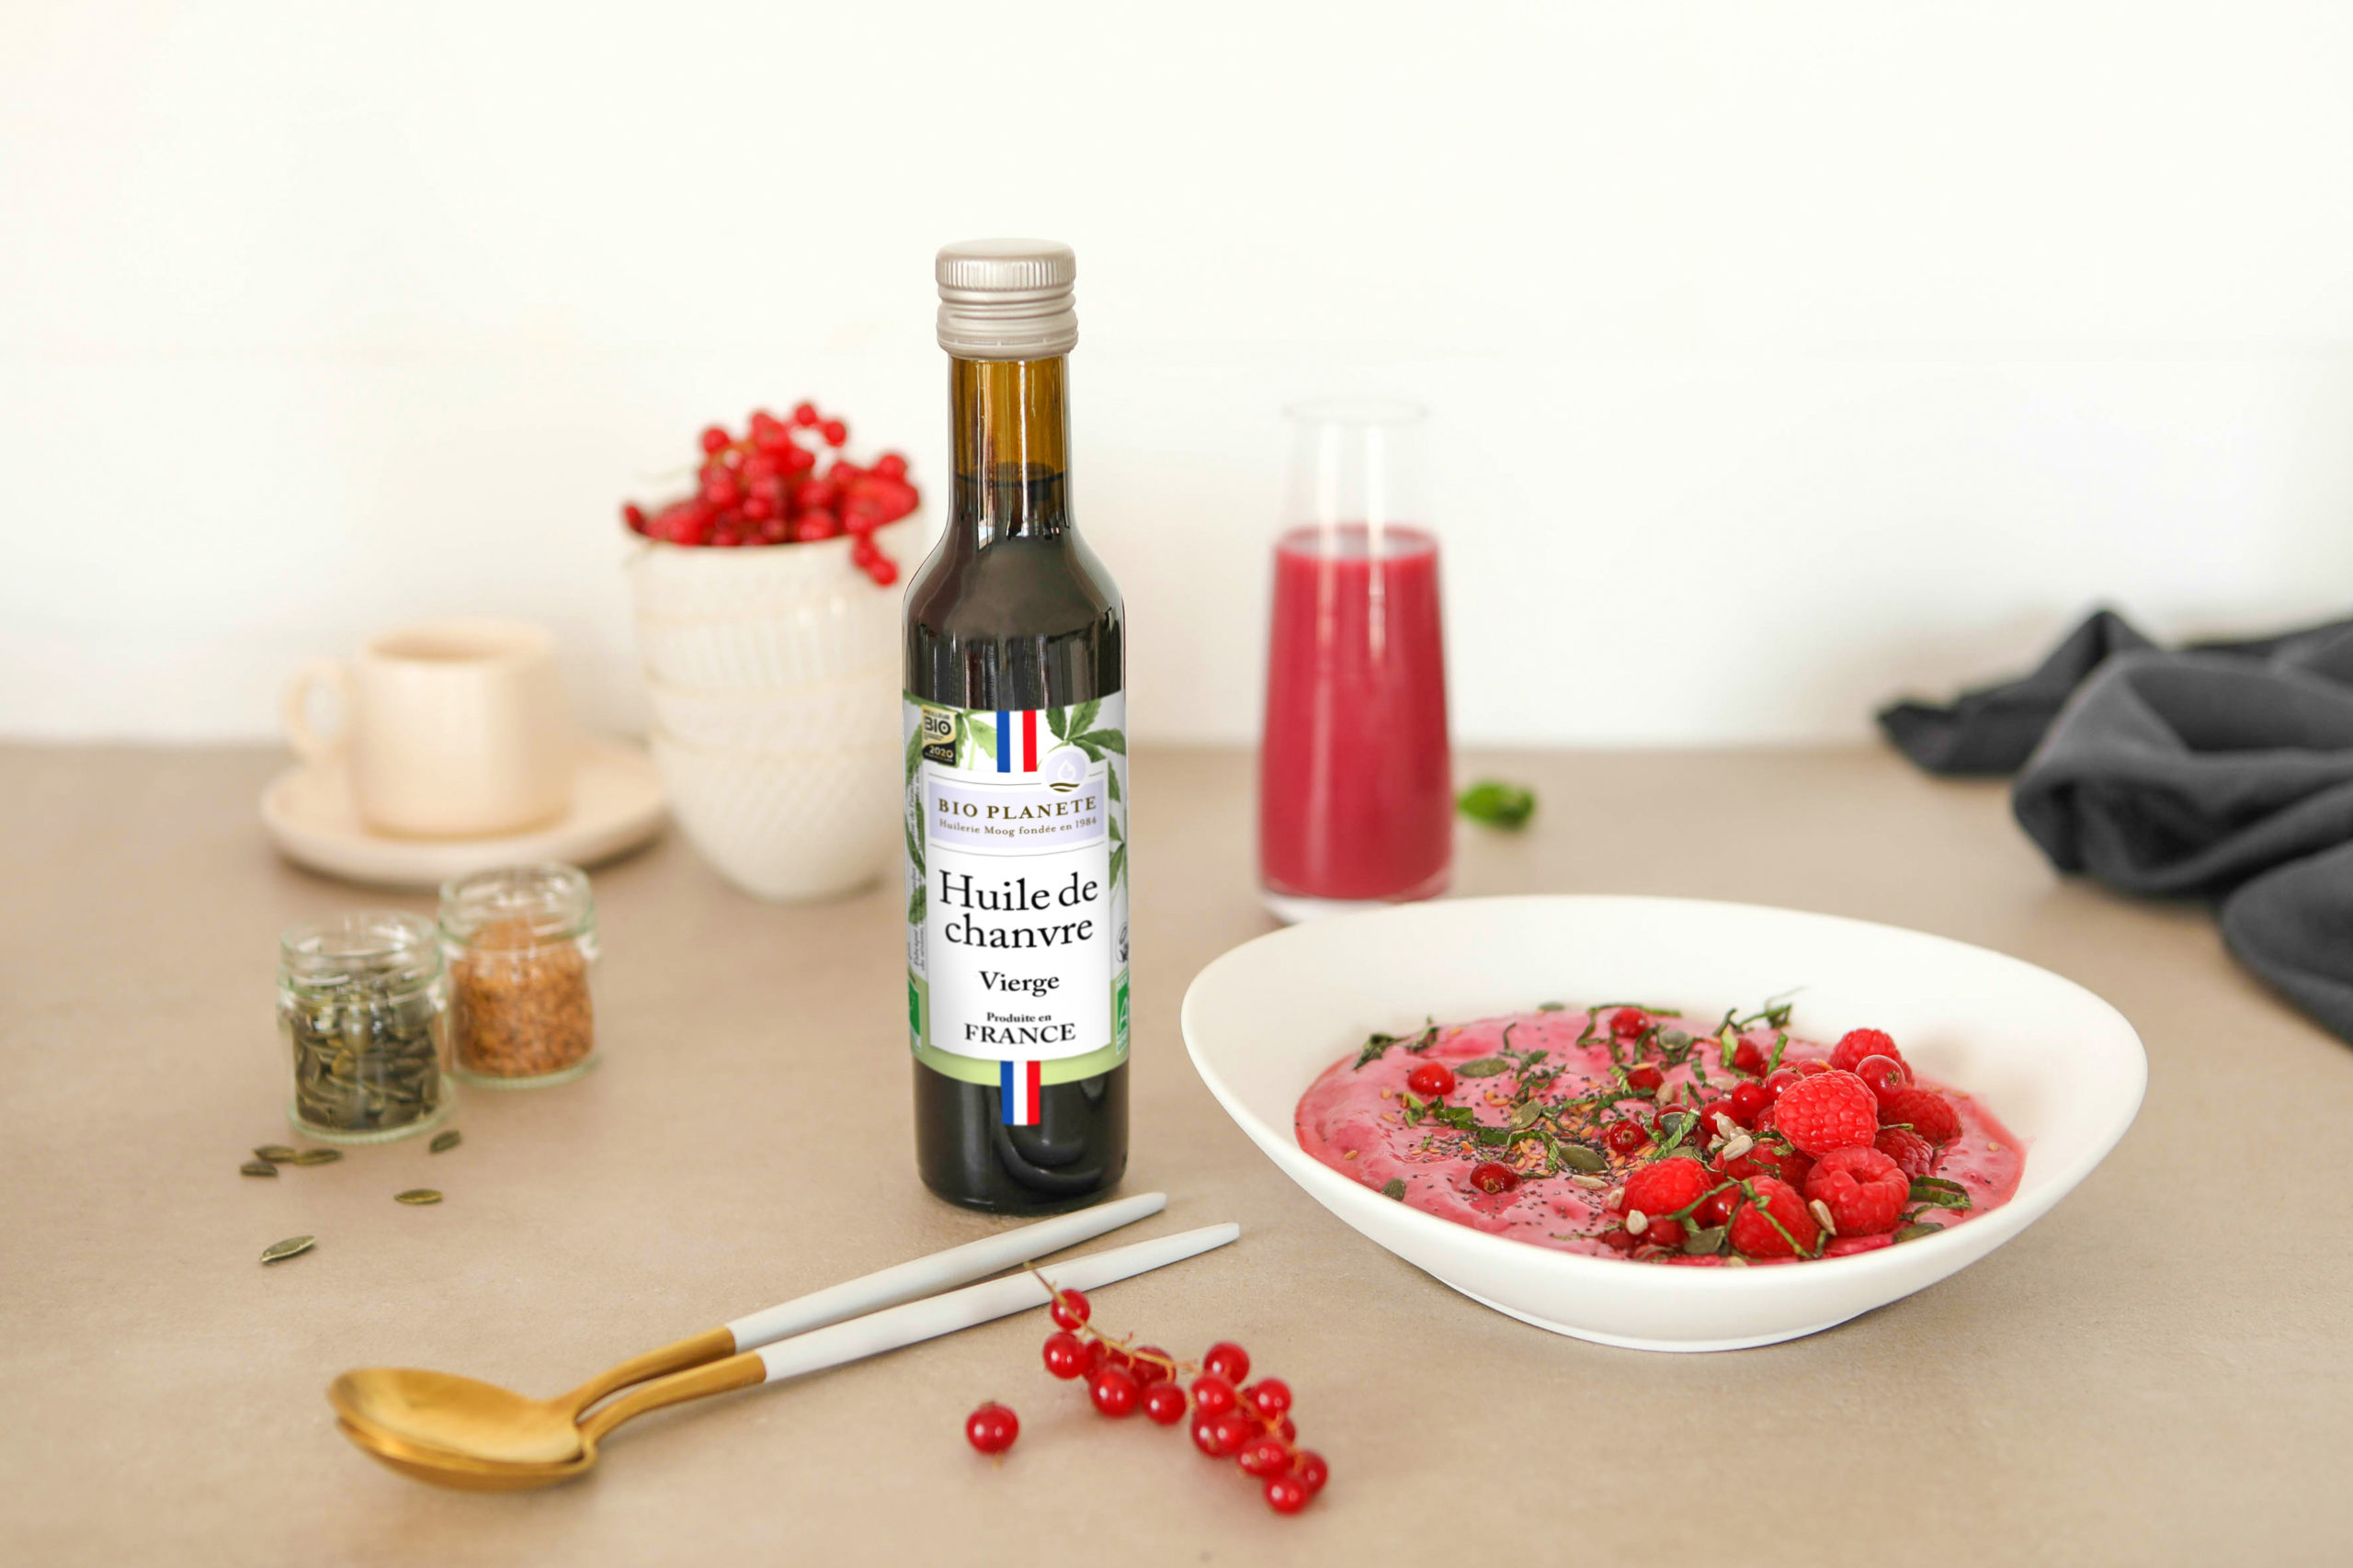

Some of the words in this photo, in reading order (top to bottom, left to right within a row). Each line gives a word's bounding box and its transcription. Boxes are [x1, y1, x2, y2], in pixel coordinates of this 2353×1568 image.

[925, 717, 951, 735] BIO
[929, 744, 954, 758] 2020
[938, 798, 978, 818] BIO
[986, 796, 1097, 820] PLANETE
[939, 818, 981, 834] Huilerie
[984, 825, 1015, 837] Moog
[1018, 824, 1057, 835] fondée
[1075, 816, 1097, 829] 1984
[938, 869, 1051, 911] Huile
[1058, 871, 1098, 907] de
[945, 913, 1094, 949] chanvre
[979, 971, 1060, 997] Vierge
[986, 1012, 1036, 1023] Produite
[1039, 1014, 1052, 1022] en
[964, 1023, 1076, 1044] FRANCE
